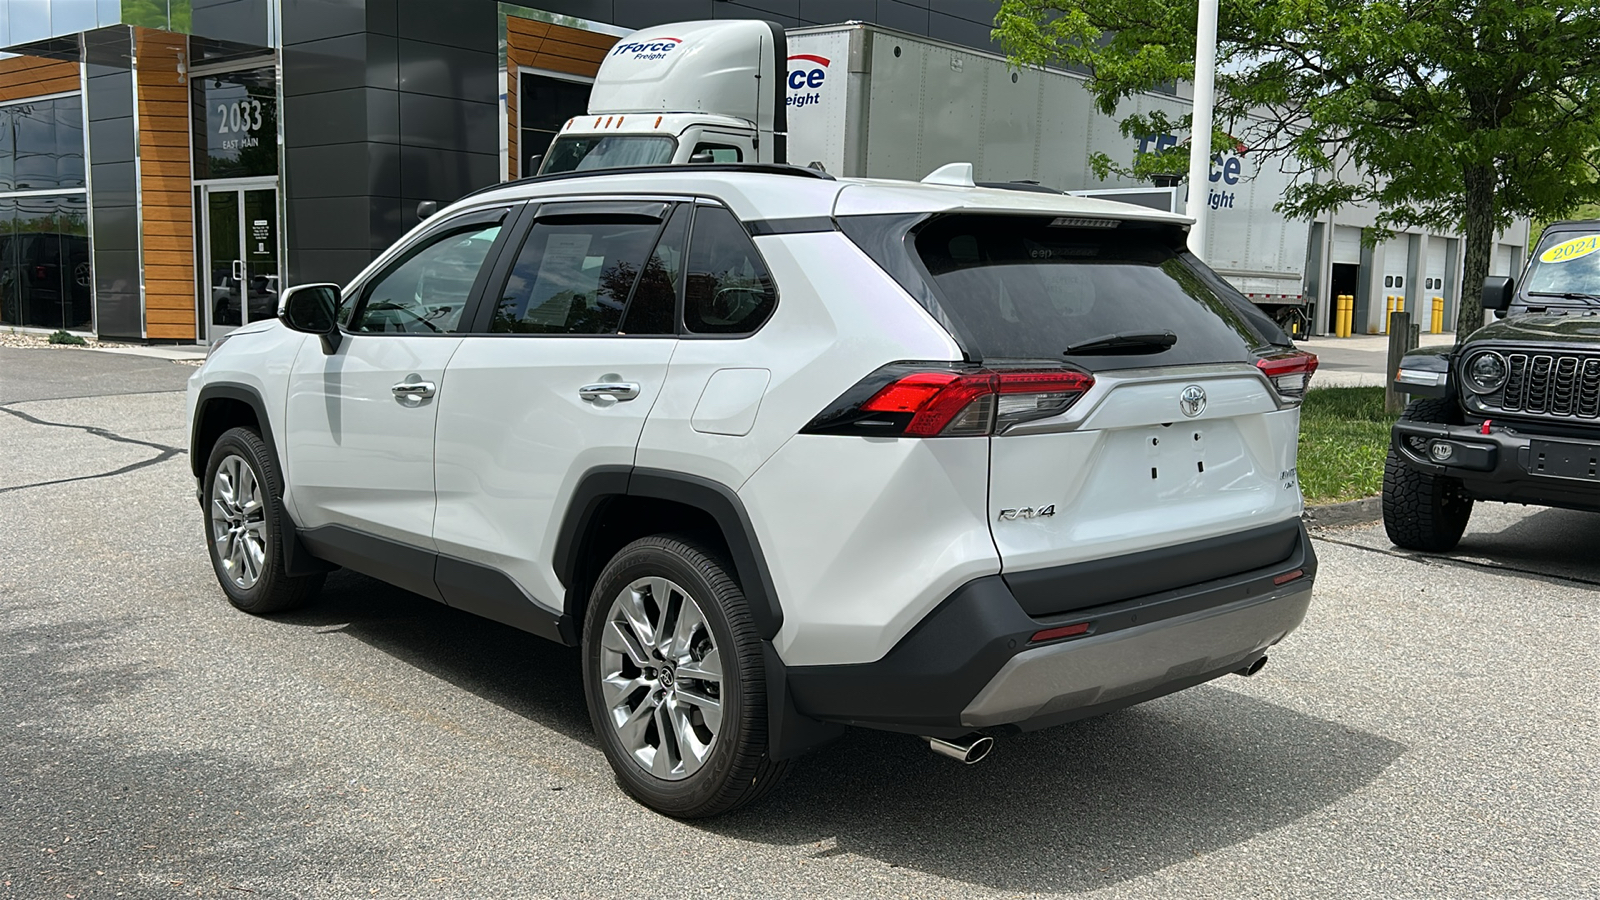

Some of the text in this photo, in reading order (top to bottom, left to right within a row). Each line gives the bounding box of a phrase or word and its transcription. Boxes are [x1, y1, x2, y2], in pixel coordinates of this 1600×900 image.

[612, 42, 676, 56] TForce
[634, 52, 666, 60] Freight
[786, 92, 820, 107] eight
[217, 100, 262, 134] 2033
[223, 138, 259, 149] EAST MAIN
[1553, 237, 1597, 260] 2024
[997, 503, 1056, 522] RAV4
